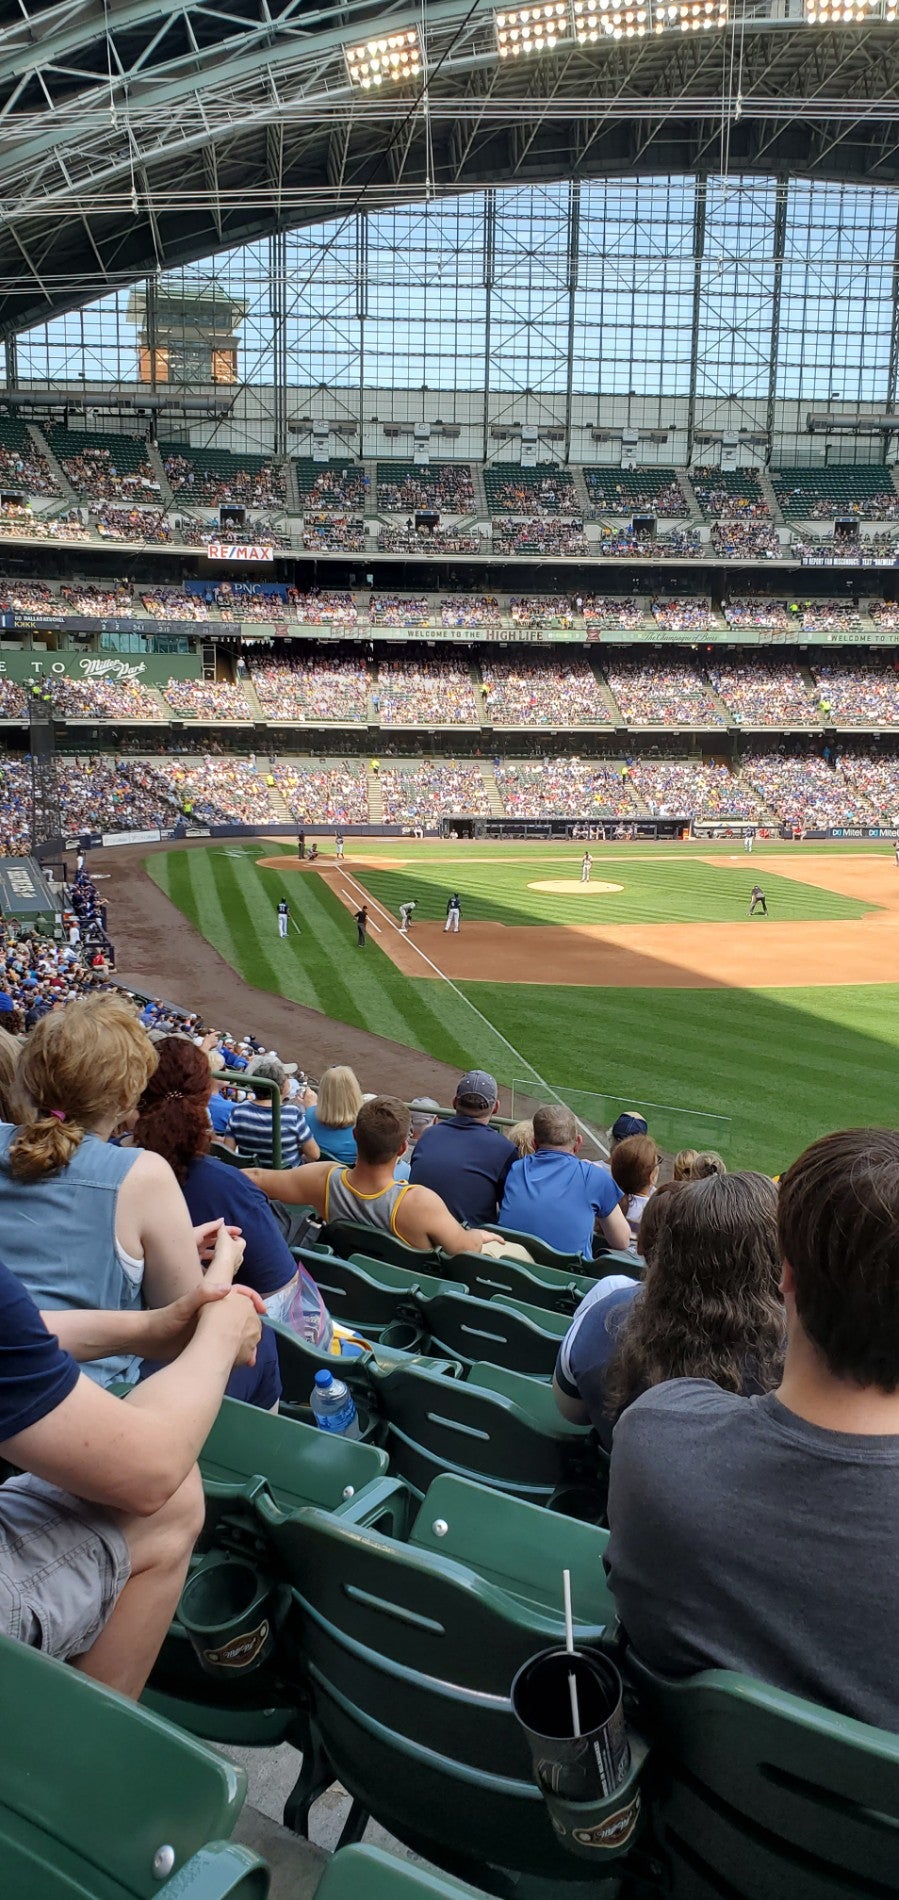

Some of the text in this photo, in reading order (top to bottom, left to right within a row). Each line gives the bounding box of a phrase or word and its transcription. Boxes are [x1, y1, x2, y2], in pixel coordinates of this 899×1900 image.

[209, 546, 270, 559] RE/MAX
[234, 583, 261, 594] PNC
[407, 630, 447, 638] WELCOME
[486, 631, 516, 640] HIGH
[519, 631, 543, 640] LIFE
[31, 662, 66, 674] TO
[80, 659, 121, 677] Miller
[843, 829, 862, 837] Mitel
